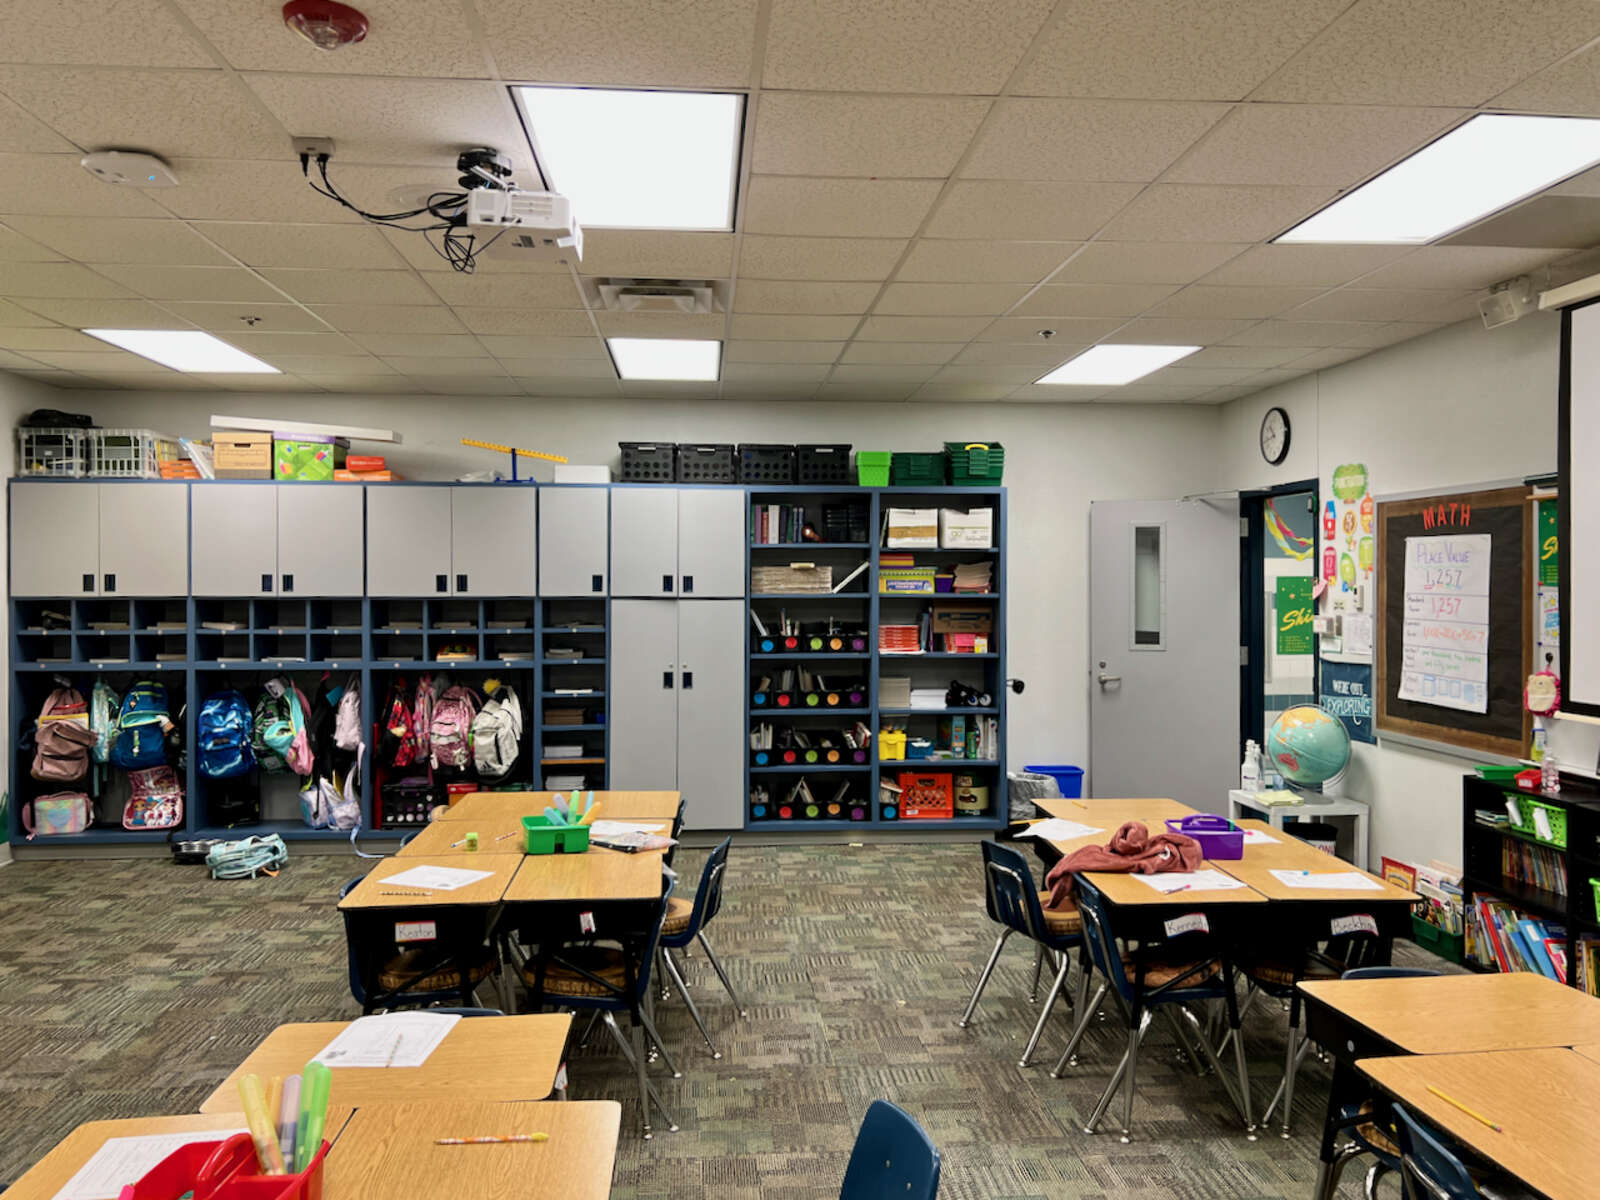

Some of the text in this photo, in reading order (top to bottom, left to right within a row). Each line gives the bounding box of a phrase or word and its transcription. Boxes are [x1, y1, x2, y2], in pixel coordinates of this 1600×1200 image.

[1422, 503, 1472, 530] MATH
[1417, 542, 1471, 564] PLACE VALUE
[1426, 568, 1463, 586] 1,257
[1431, 596, 1463, 618] 1,257
